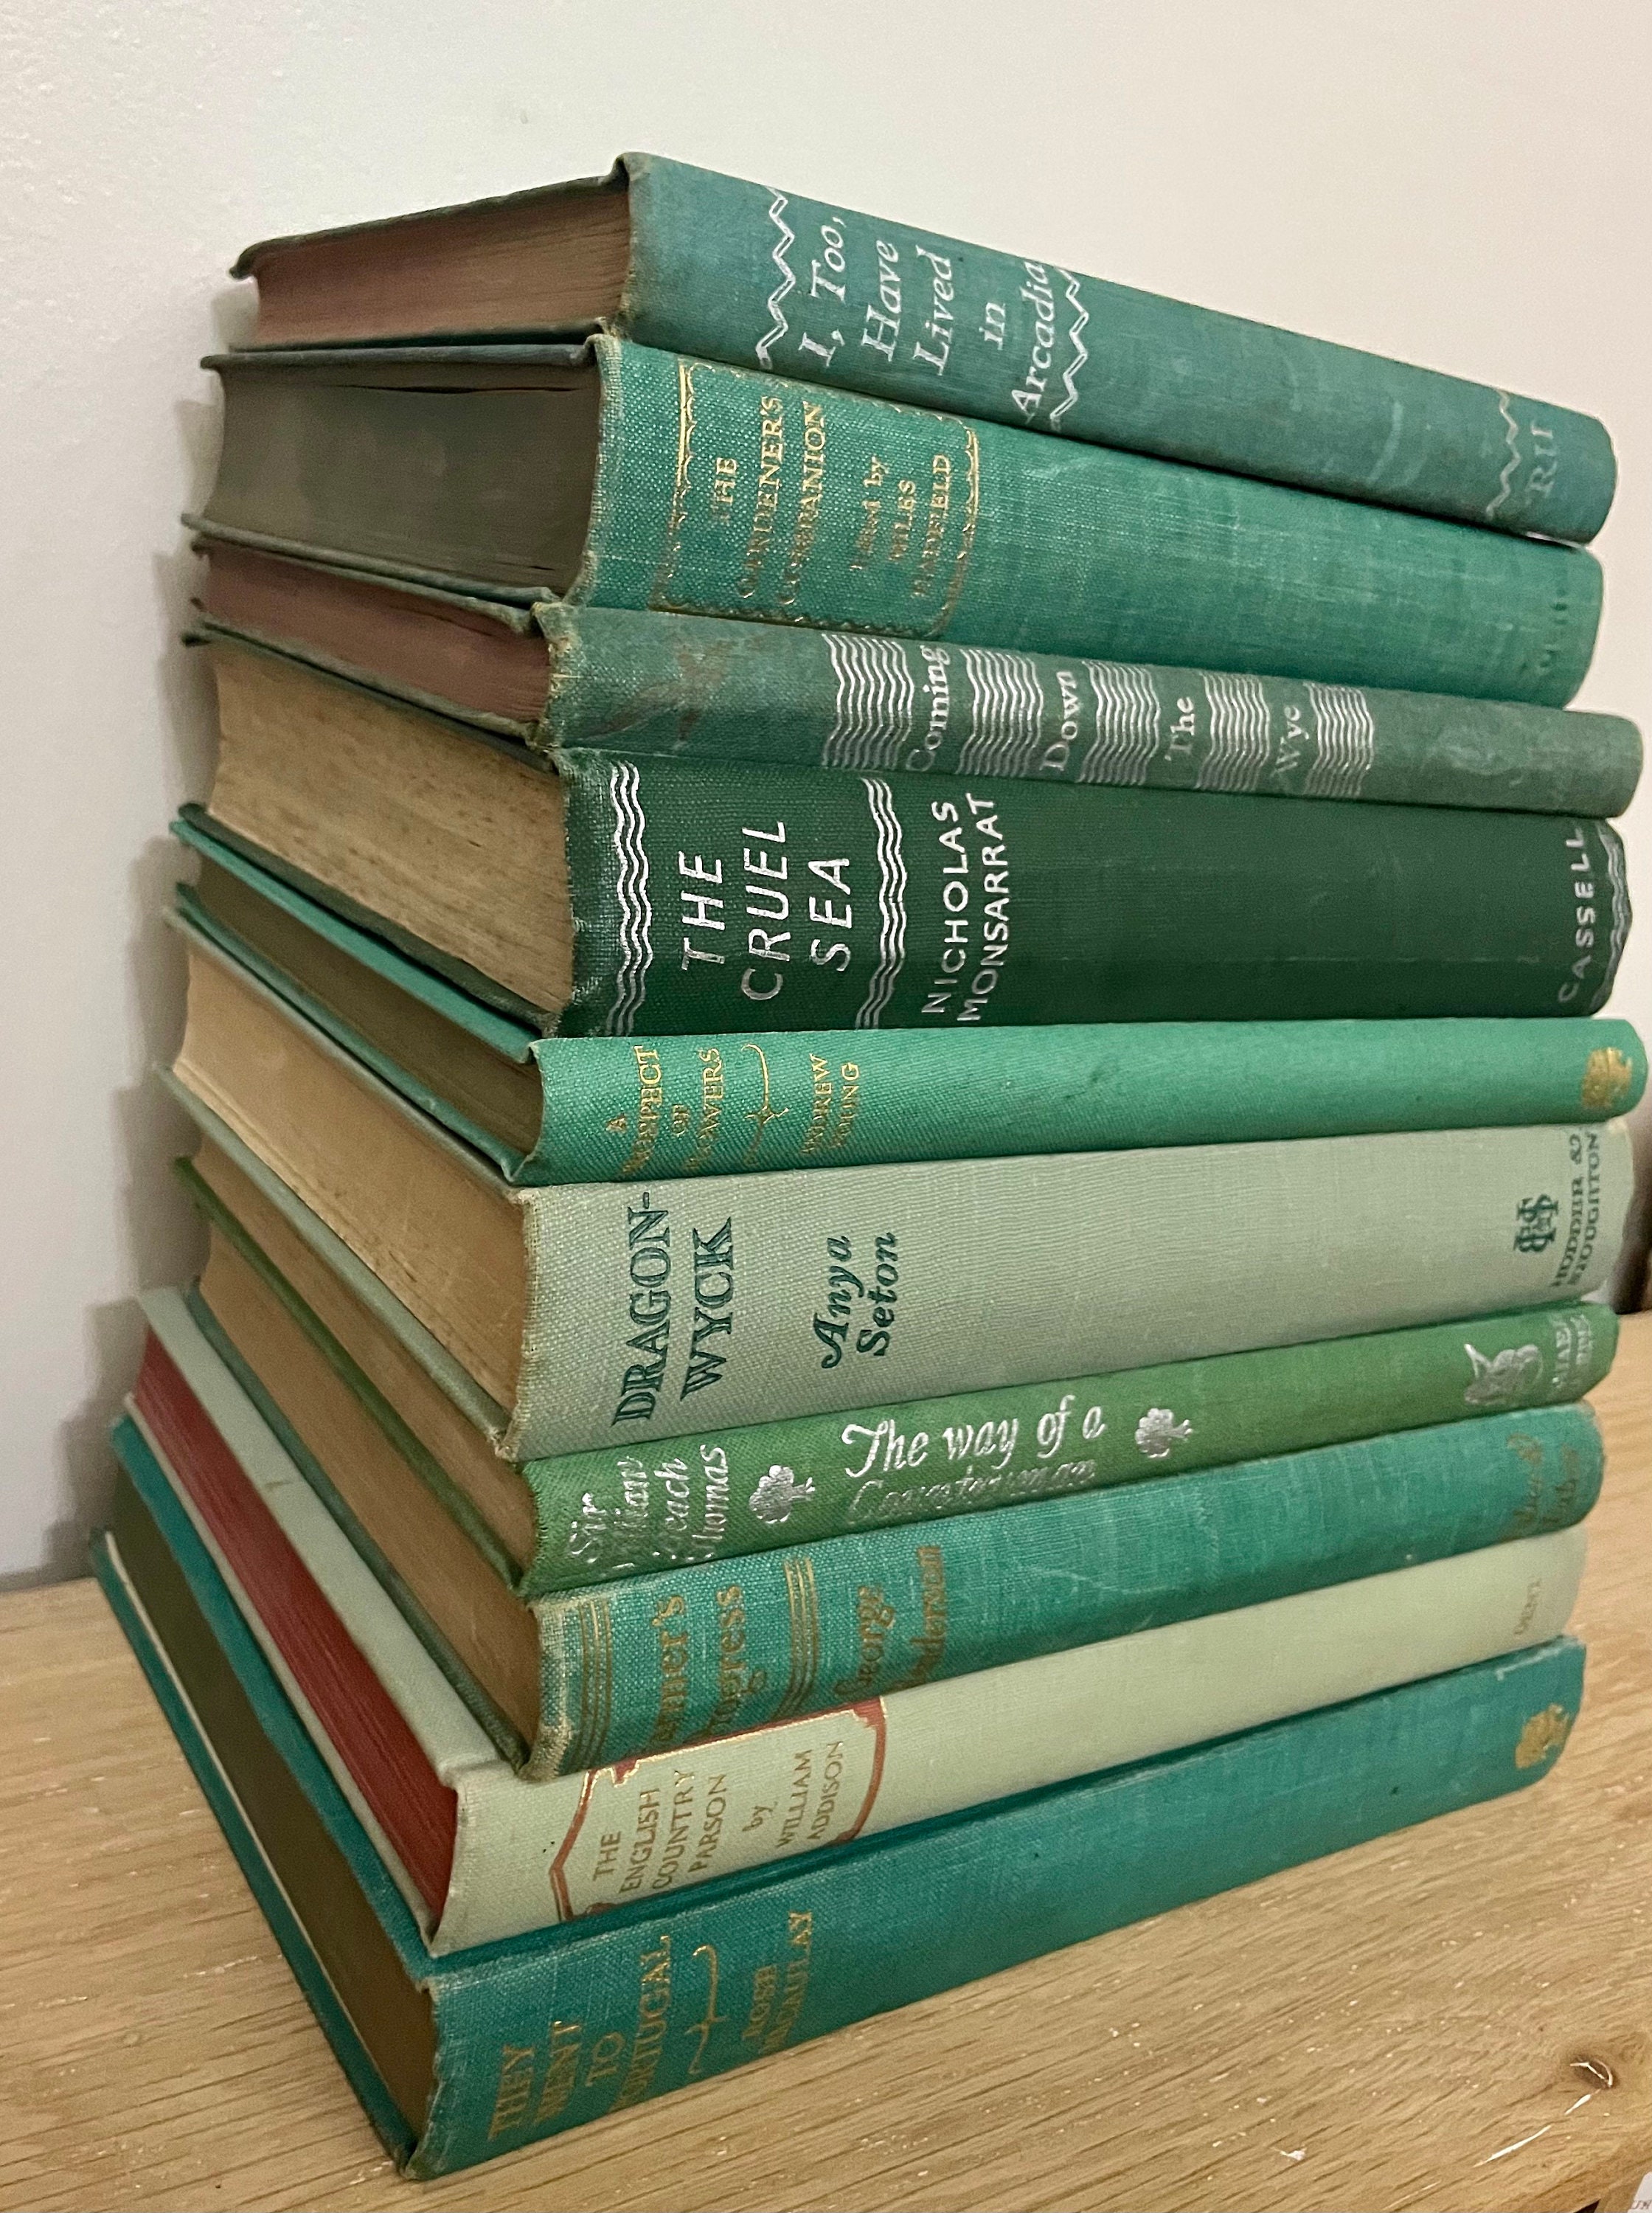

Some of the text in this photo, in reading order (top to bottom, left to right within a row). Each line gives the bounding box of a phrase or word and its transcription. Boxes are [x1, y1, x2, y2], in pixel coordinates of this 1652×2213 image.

[799, 217, 847, 367] I, Too,
[861, 240, 902, 362] Have
[913, 245, 955, 376] Lived
[979, 301, 1006, 351] in
[1011, 260, 1055, 424] Arcadia
[711, 457, 738, 524] HE
[740, 395, 785, 599] RDENER'S
[779, 401, 825, 606] CPANION
[905, 645, 951, 772] Coming
[1039, 671, 1080, 772] Down
[1165, 696, 1195, 762] The
[1270, 705, 1310, 778] Wye
[678, 851, 725, 971] THE
[740, 821, 791, 1001] CRUEL
[808, 858, 853, 972] SEA
[921, 800, 969, 1014] NICHOLAS
[957, 792, 1010, 1022] MONSARRAT
[1558, 827, 1597, 1003] CASSELL
[684, 1047, 723, 1170] OWERS
[611, 1191, 672, 1427] DRAGON-
[680, 1216, 735, 1401] WYCK
[813, 1235, 864, 1370] Anya
[856, 1232, 900, 1357] Seton
[841, 1394, 1106, 1478] The way of a
[653, 1457, 690, 1559] each
[685, 1444, 729, 1561] homas
[649, 1594, 690, 1745] armer's
[701, 1585, 766, 1737] rogress
[898, 1545, 948, 1689] derson
[619, 1787, 661, 1894] ENGLISH
[652, 1770, 695, 1889] COUNTRY
[688, 1773, 727, 1873] PARSON
[743, 1801, 777, 1832] by
[777, 1749, 813, 1847] WILLIAM
[808, 1741, 843, 1839] ADDISON
[594, 1830, 621, 1881] THE
[487, 2045, 535, 2141] THEY
[535, 2020, 584, 2126] WENT
[586, 2031, 626, 2087] TO
